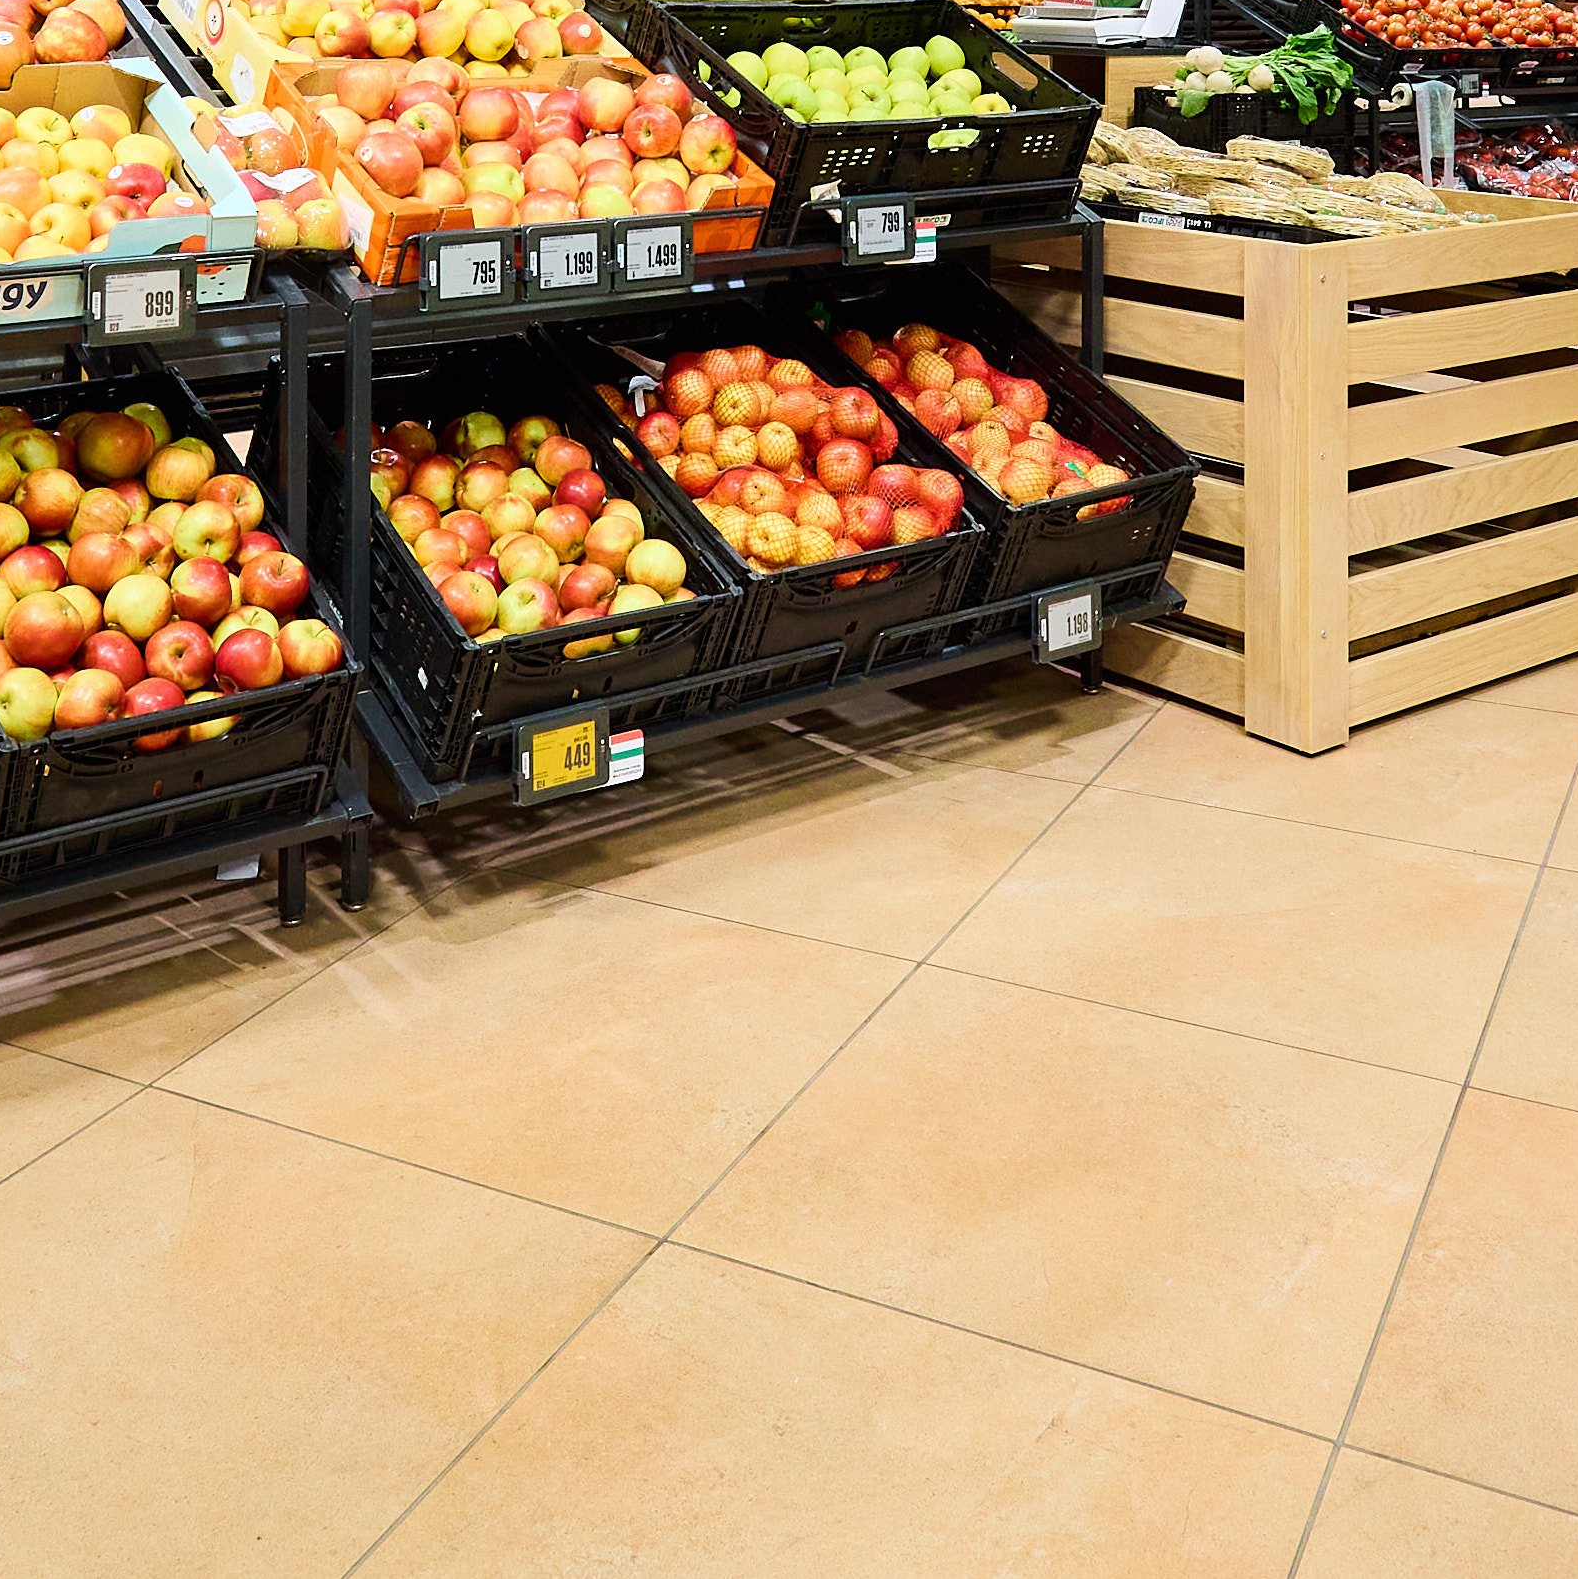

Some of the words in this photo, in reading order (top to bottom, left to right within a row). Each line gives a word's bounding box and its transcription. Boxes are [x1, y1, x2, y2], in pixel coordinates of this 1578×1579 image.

[881, 211, 900, 234] 799
[565, 251, 593, 276] 1.199
[647, 243, 677, 268] 1.499
[473, 259, 496, 286] 795
[145, 290, 174, 317] 899
[1067, 612, 1088, 637] 1.198
[564, 742, 590, 771] 449
